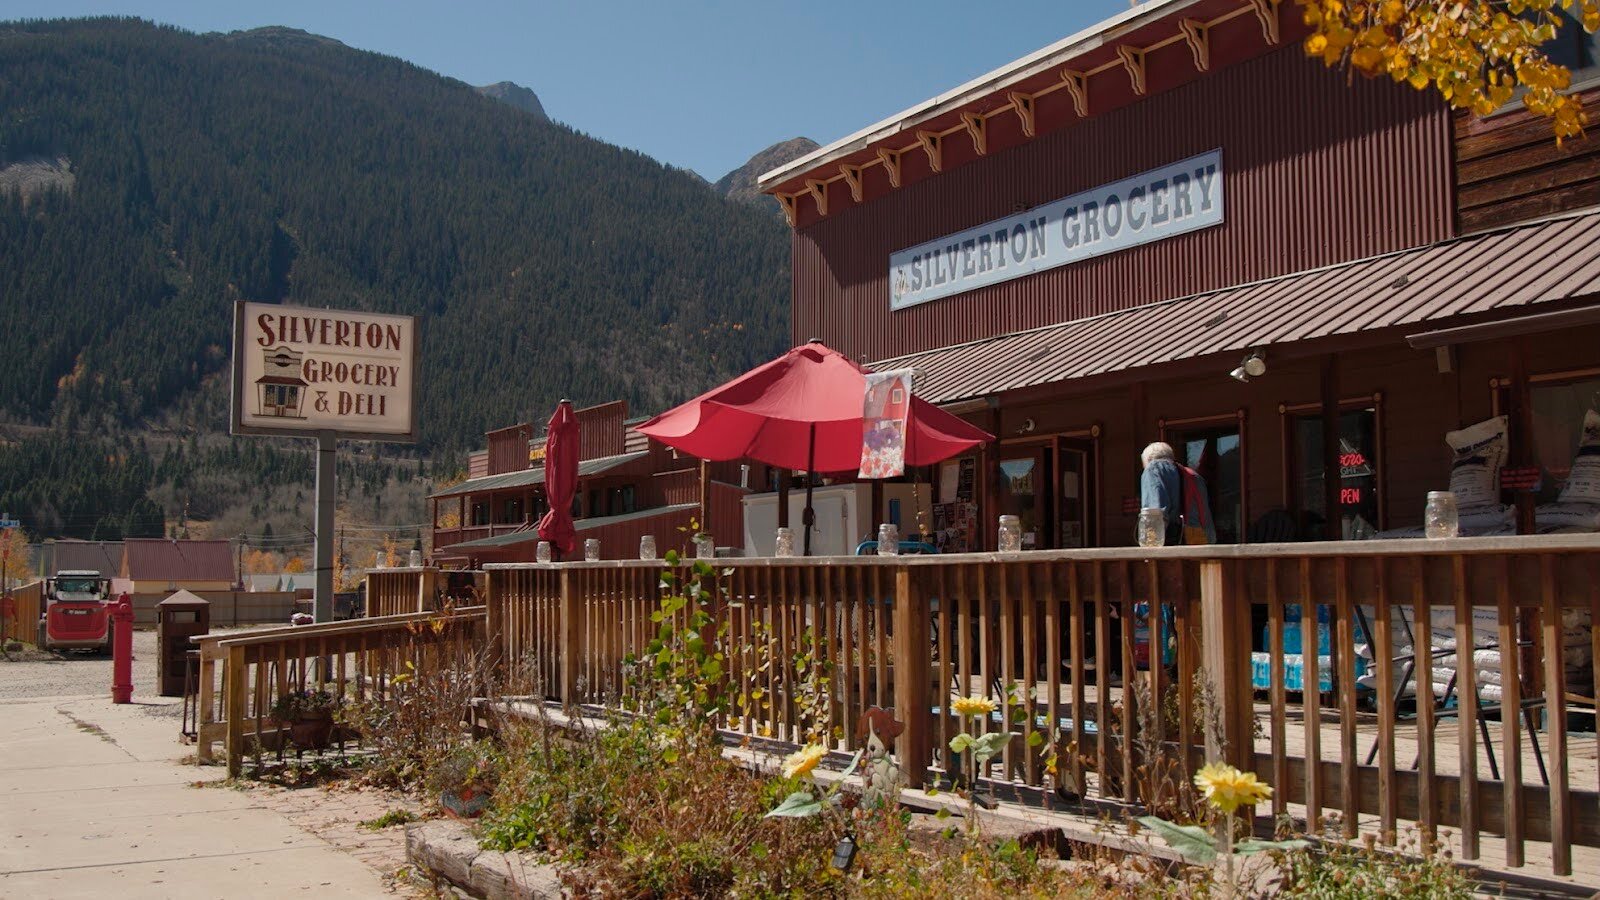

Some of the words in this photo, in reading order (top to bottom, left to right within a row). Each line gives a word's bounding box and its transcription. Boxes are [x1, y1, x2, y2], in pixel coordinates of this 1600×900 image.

[911, 216, 1048, 294] SILVERTON
[1061, 163, 1217, 251] GROCERY
[257, 313, 402, 351] SILVERTON
[303, 358, 400, 387] GROCERY
[314, 390, 331, 413] &
[338, 390, 387, 417] DELI
[1340, 466, 1358, 475] GHT
[1341, 488, 1360, 504] PEN
